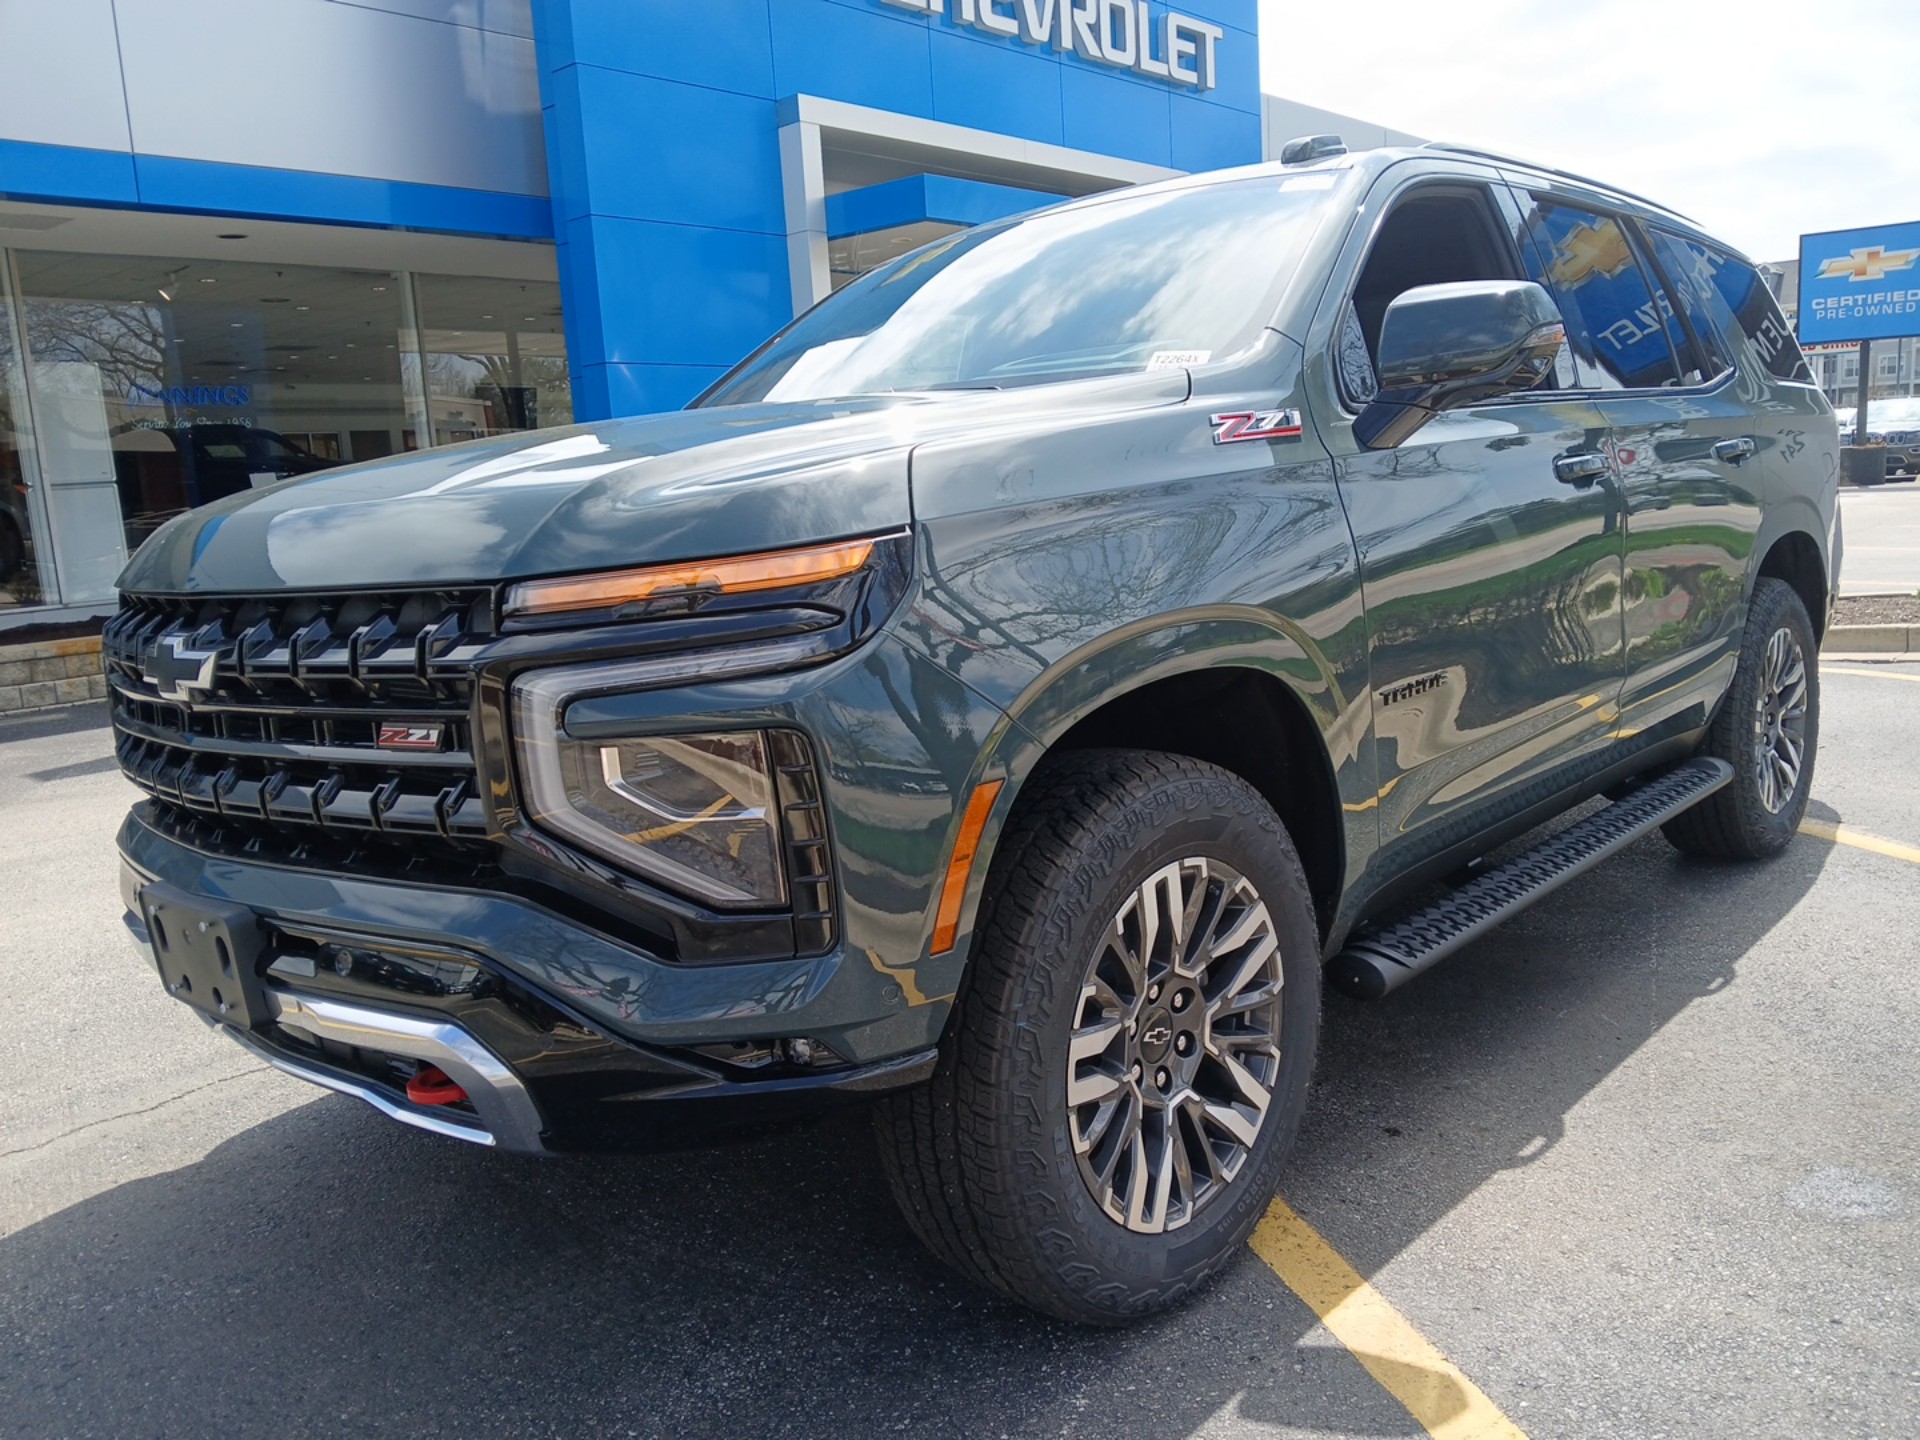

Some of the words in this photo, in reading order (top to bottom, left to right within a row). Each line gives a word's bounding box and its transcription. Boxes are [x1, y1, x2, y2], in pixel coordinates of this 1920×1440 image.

[1811, 289, 1920, 309] CERTIFIED
[1816, 301, 1917, 320] PRE-OWNED
[128, 384, 252, 410] JNNINGS
[1209, 408, 1303, 444] Z71
[379, 727, 440, 748] Z71
